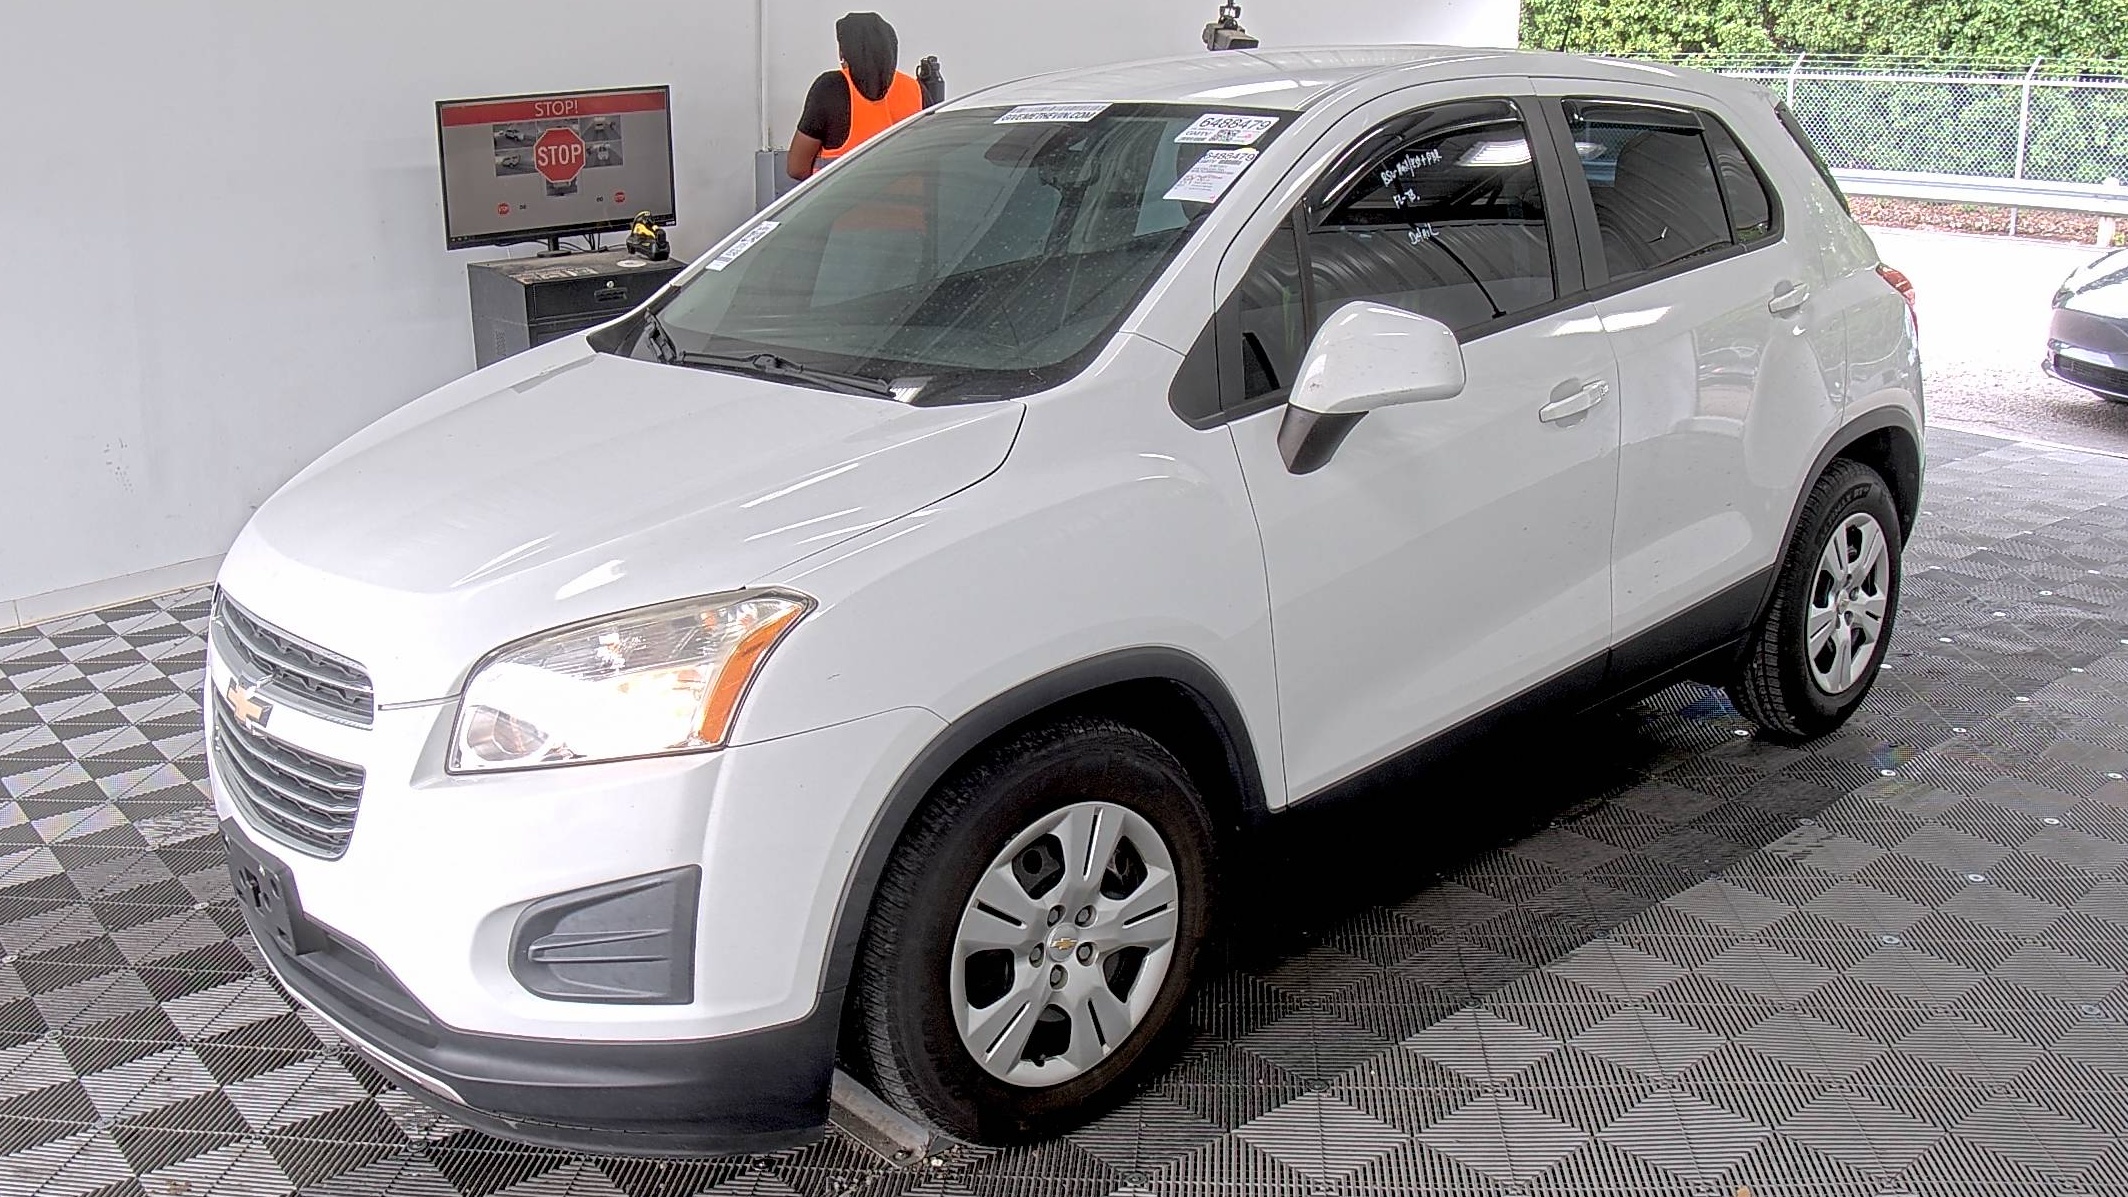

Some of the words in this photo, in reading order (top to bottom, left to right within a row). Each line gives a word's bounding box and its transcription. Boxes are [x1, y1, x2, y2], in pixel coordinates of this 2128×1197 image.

[534, 99, 579, 117] STOP!
[1199, 117, 1272, 131] 6488479
[537, 145, 582, 167] STOP
